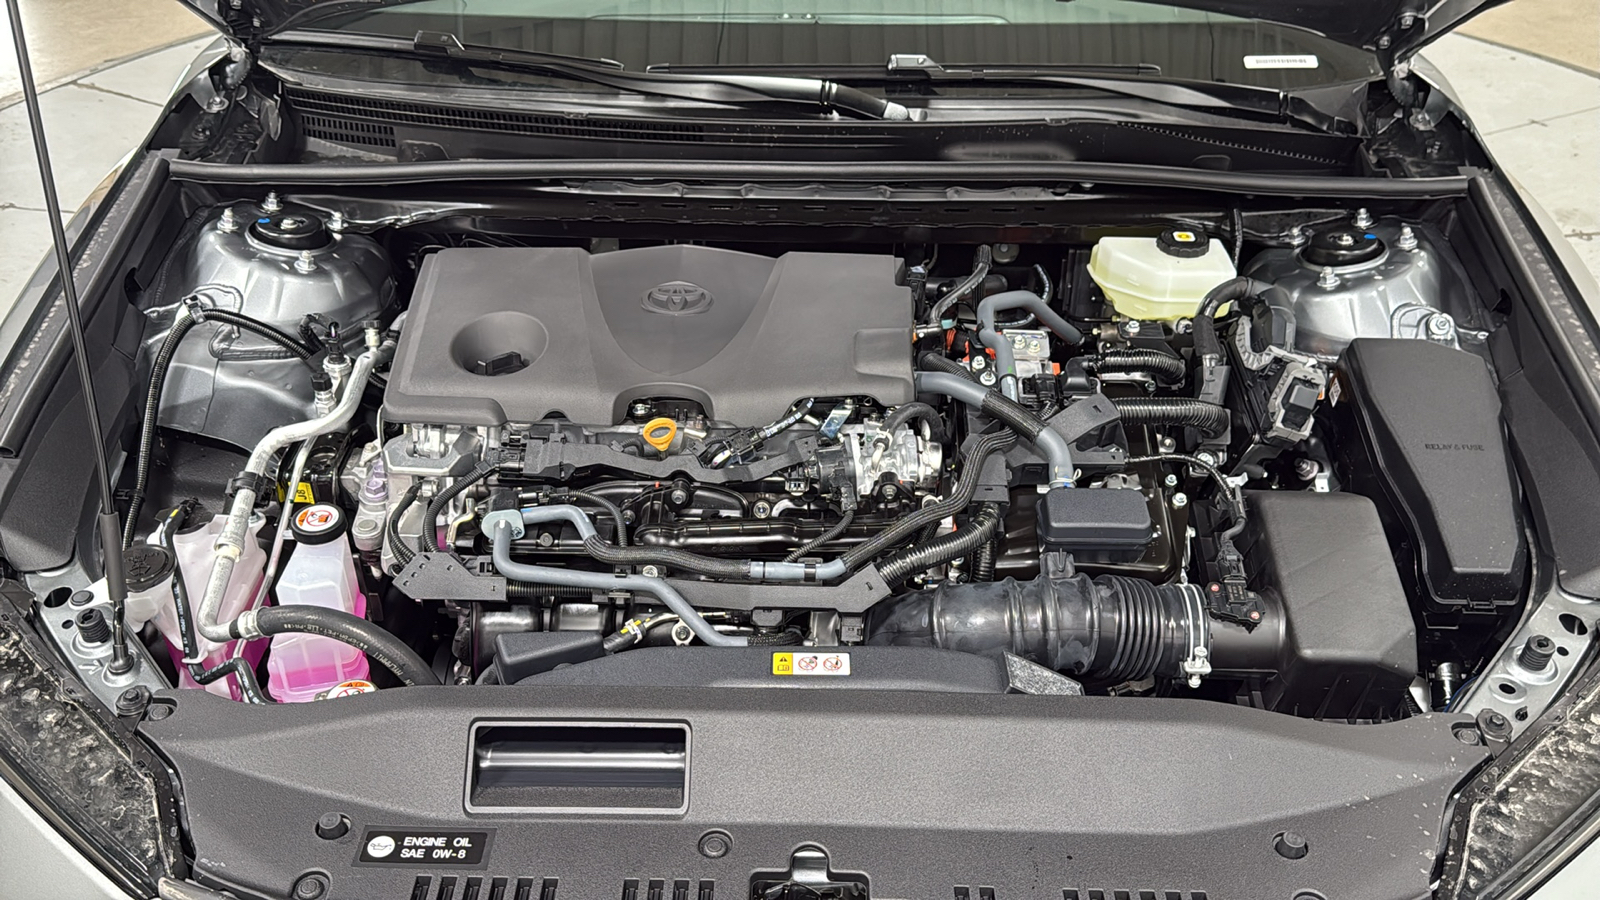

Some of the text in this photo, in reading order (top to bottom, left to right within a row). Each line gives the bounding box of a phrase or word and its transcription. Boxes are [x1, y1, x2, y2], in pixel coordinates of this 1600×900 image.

[296, 489, 307, 500] J8
[403, 837, 472, 847] ENGINE OIL
[400, 849, 466, 859] SAE 0W-8
